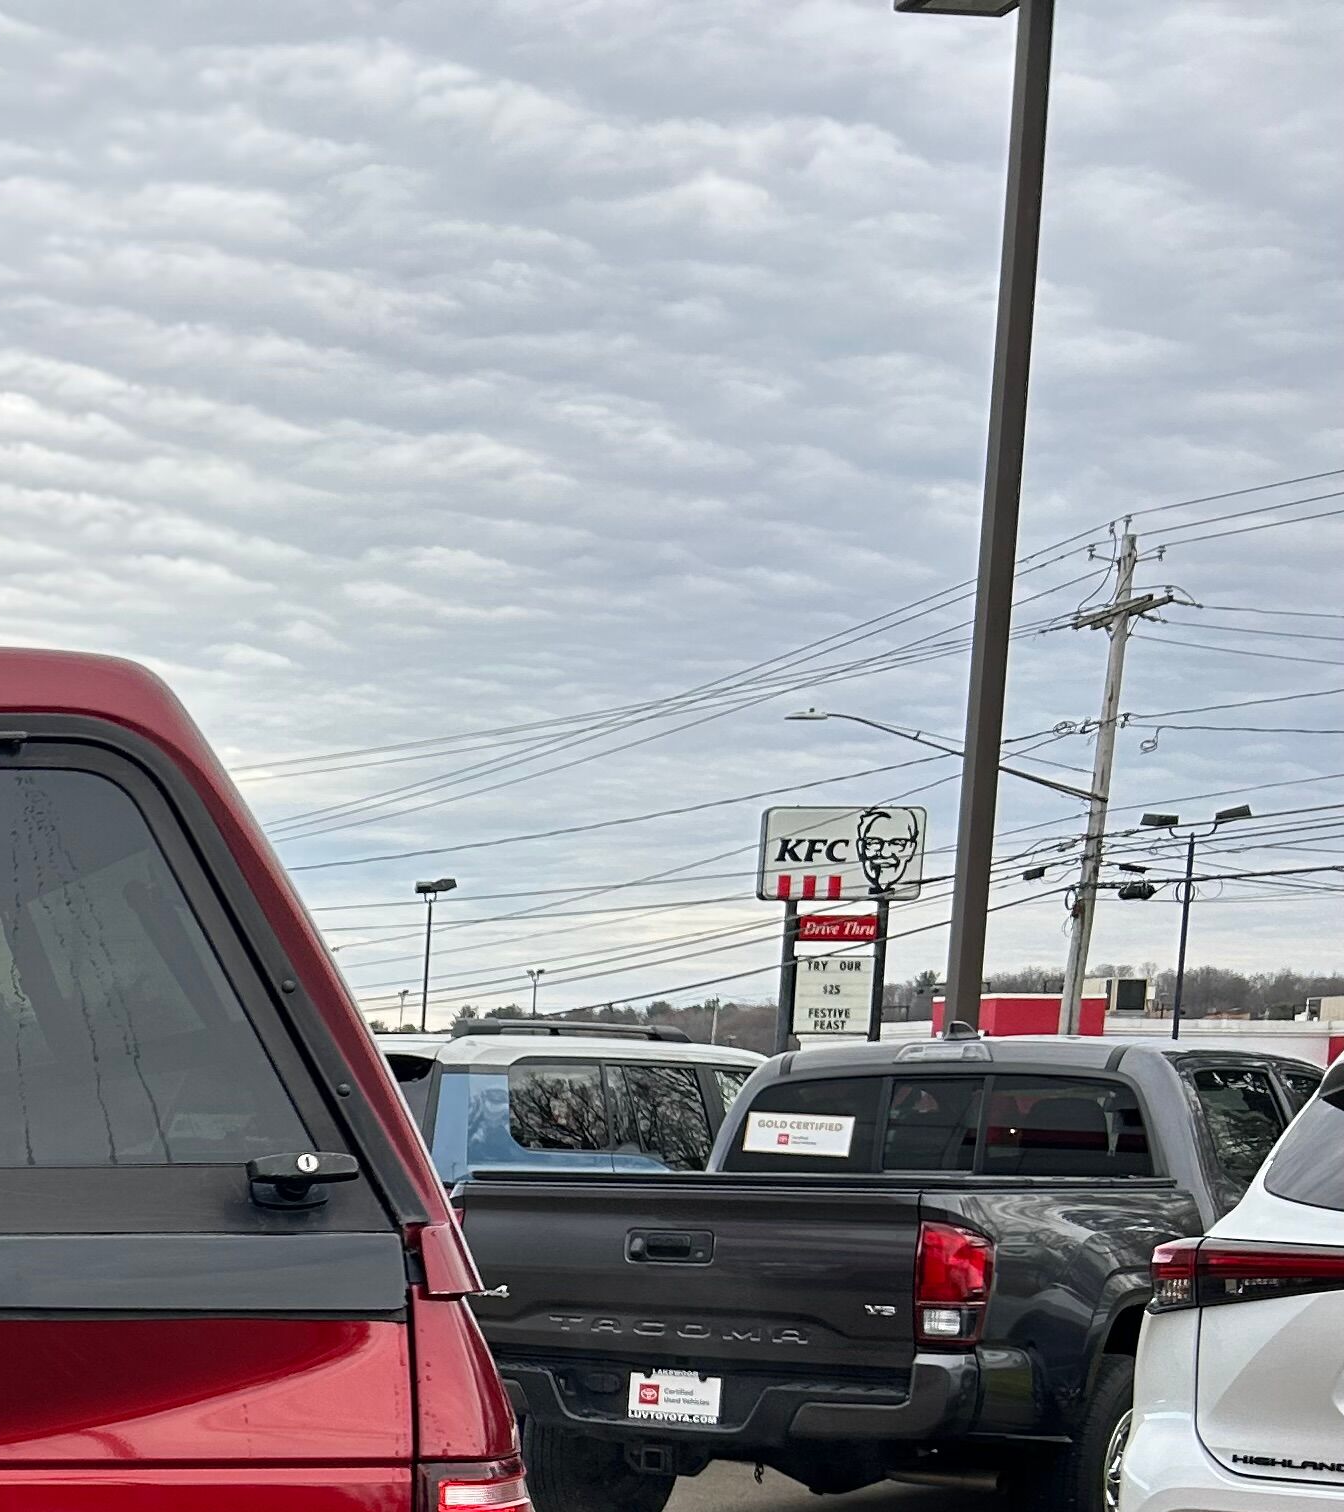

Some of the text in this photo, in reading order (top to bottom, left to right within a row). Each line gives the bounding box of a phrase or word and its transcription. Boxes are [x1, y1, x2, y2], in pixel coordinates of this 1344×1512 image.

[774, 838, 849, 863] KFC
[804, 921, 875, 935] Drive Thru
[807, 960, 861, 971] TRY OUR
[822, 984, 841, 995] $25
[808, 1007, 851, 1019] FESTIVE
[813, 1020, 846, 1031] FEAST
[757, 1119, 843, 1132] GOLD CERTIFIED
[548, 1314, 809, 1345] TACOMA
[628, 1409, 717, 1425] LUVTOYOTA.COM
